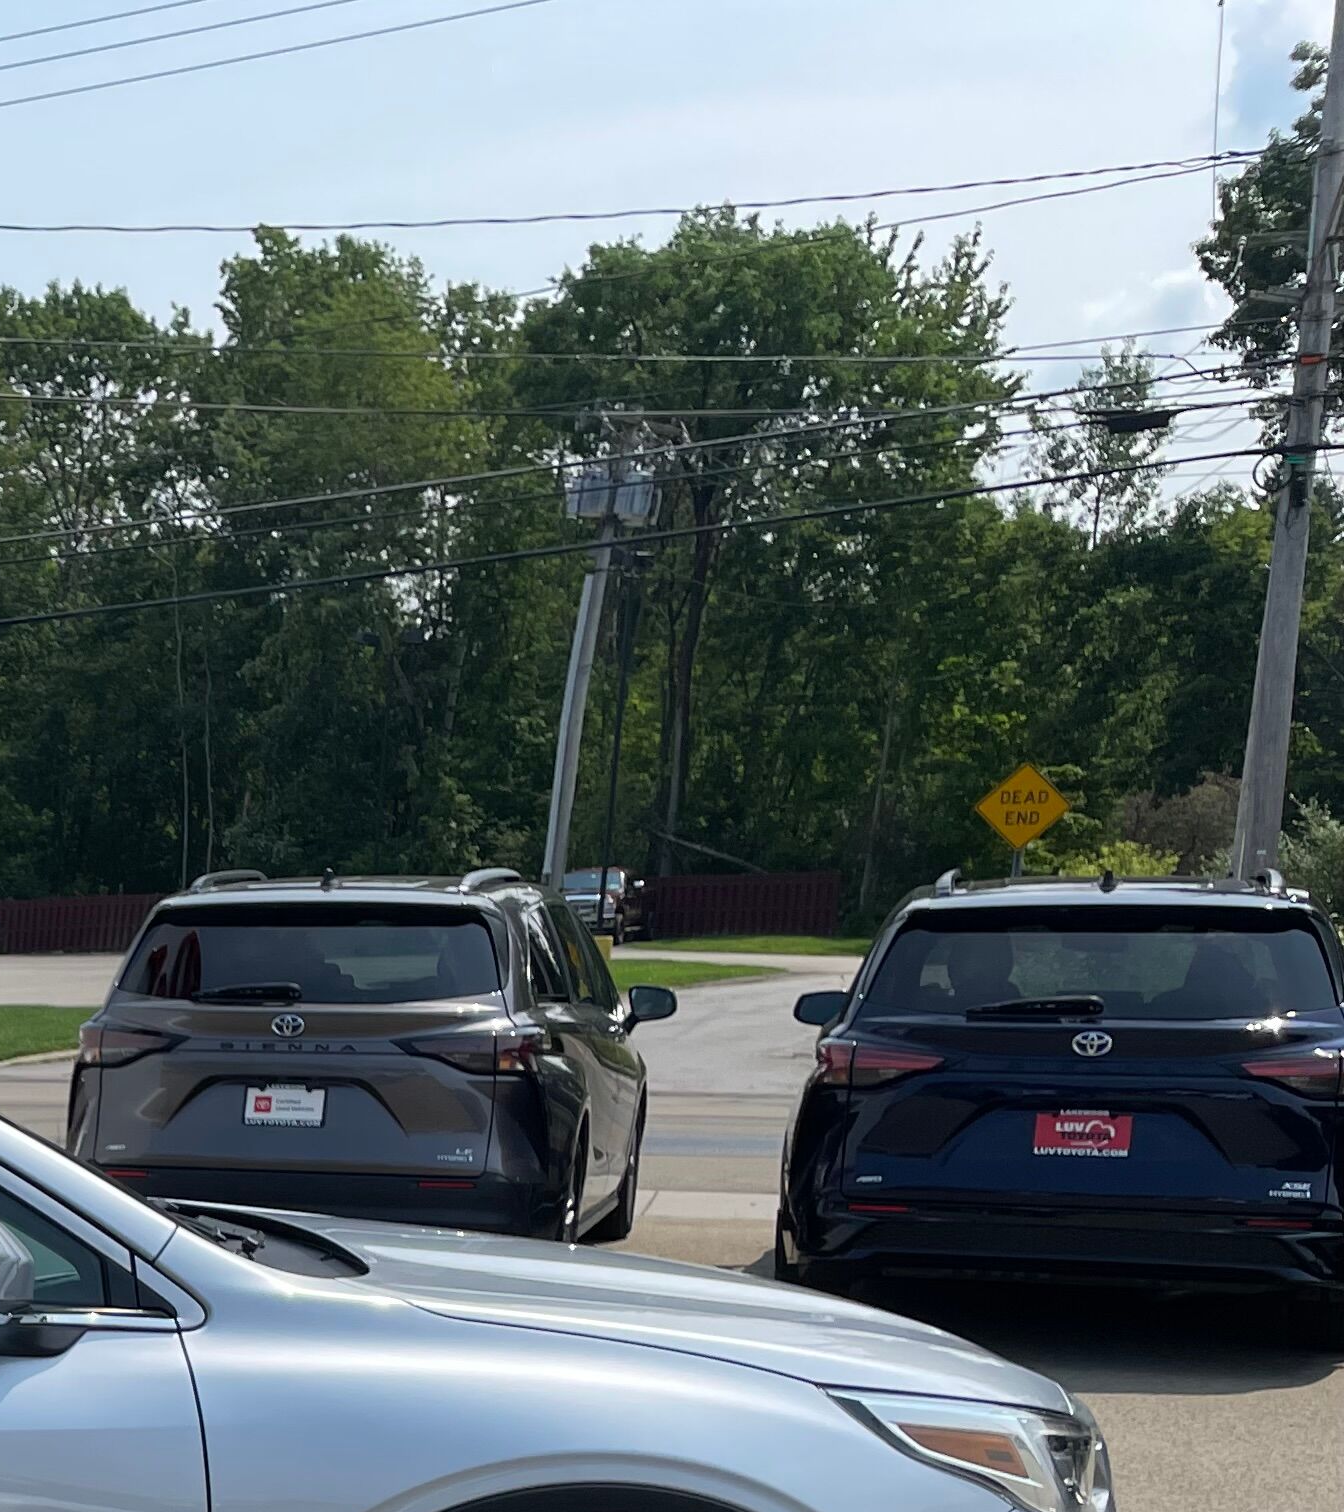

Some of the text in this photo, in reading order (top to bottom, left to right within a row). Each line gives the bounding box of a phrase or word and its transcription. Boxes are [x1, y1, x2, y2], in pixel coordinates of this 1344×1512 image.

[1000, 790, 1050, 806] DEAD
[1005, 811, 1040, 826] END
[220, 1041, 357, 1051] SIENNA
[1055, 1122, 1085, 1132] LUV
[1061, 1131, 1111, 1140] TOYOTA
[1033, 1146, 1129, 1157] LUVTOYOTA.COM
